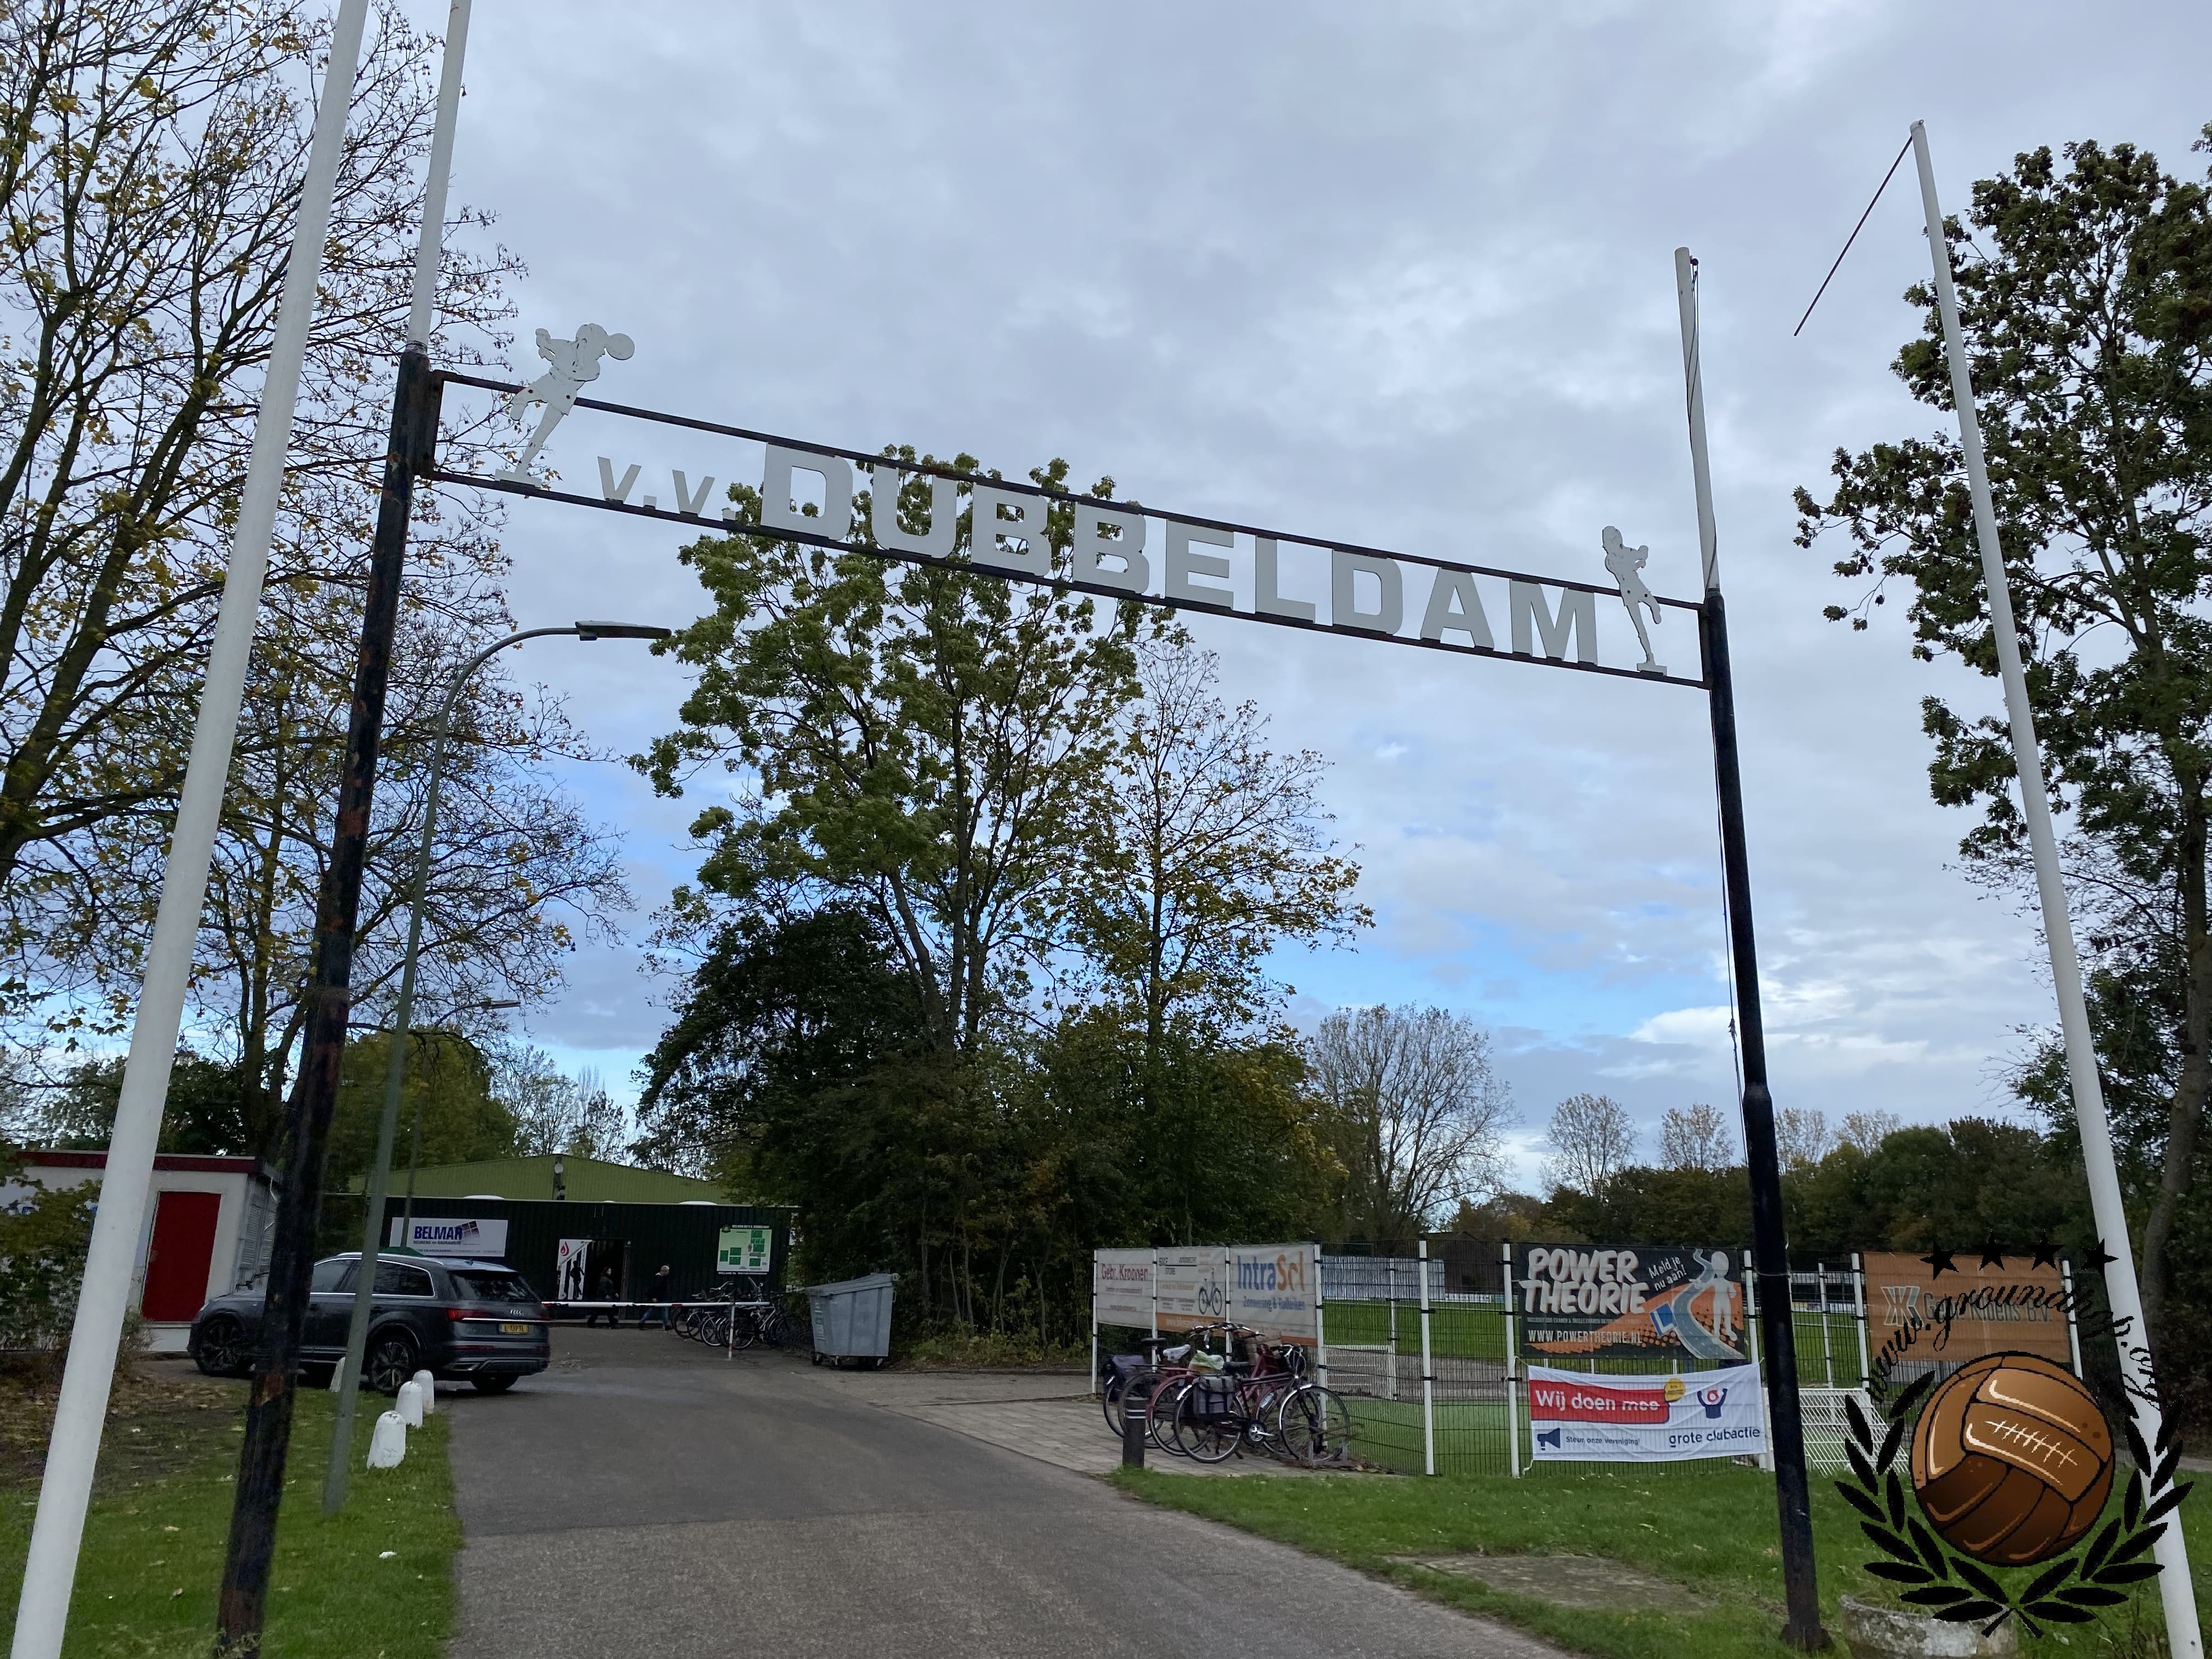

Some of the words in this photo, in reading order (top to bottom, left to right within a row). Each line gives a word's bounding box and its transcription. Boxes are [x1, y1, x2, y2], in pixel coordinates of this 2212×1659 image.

[760, 443, 1598, 665] DUBBELDAM
[414, 1226, 462, 1240] BELMAR
[1528, 1248, 1639, 1283] POWER
[1648, 1258, 1672, 1279] Meld
[1671, 1256, 1681, 1271] je
[1654, 1279, 1666, 1291] nu
[1667, 1263, 1687, 1284] aan!
[1519, 1280, 1650, 1314] THEORIE
[1527, 1329, 1643, 1344] WWW.POWERTHEORIE.NL
[1536, 1390, 1566, 1411] Wij
[1571, 1391, 1616, 1411] doen
[1622, 1400, 1661, 1411] mee
[1604, 1437, 1640, 1446] vereniging!
[1669, 1431, 1702, 1448] grote
[1706, 1426, 1760, 1442] clubactie
